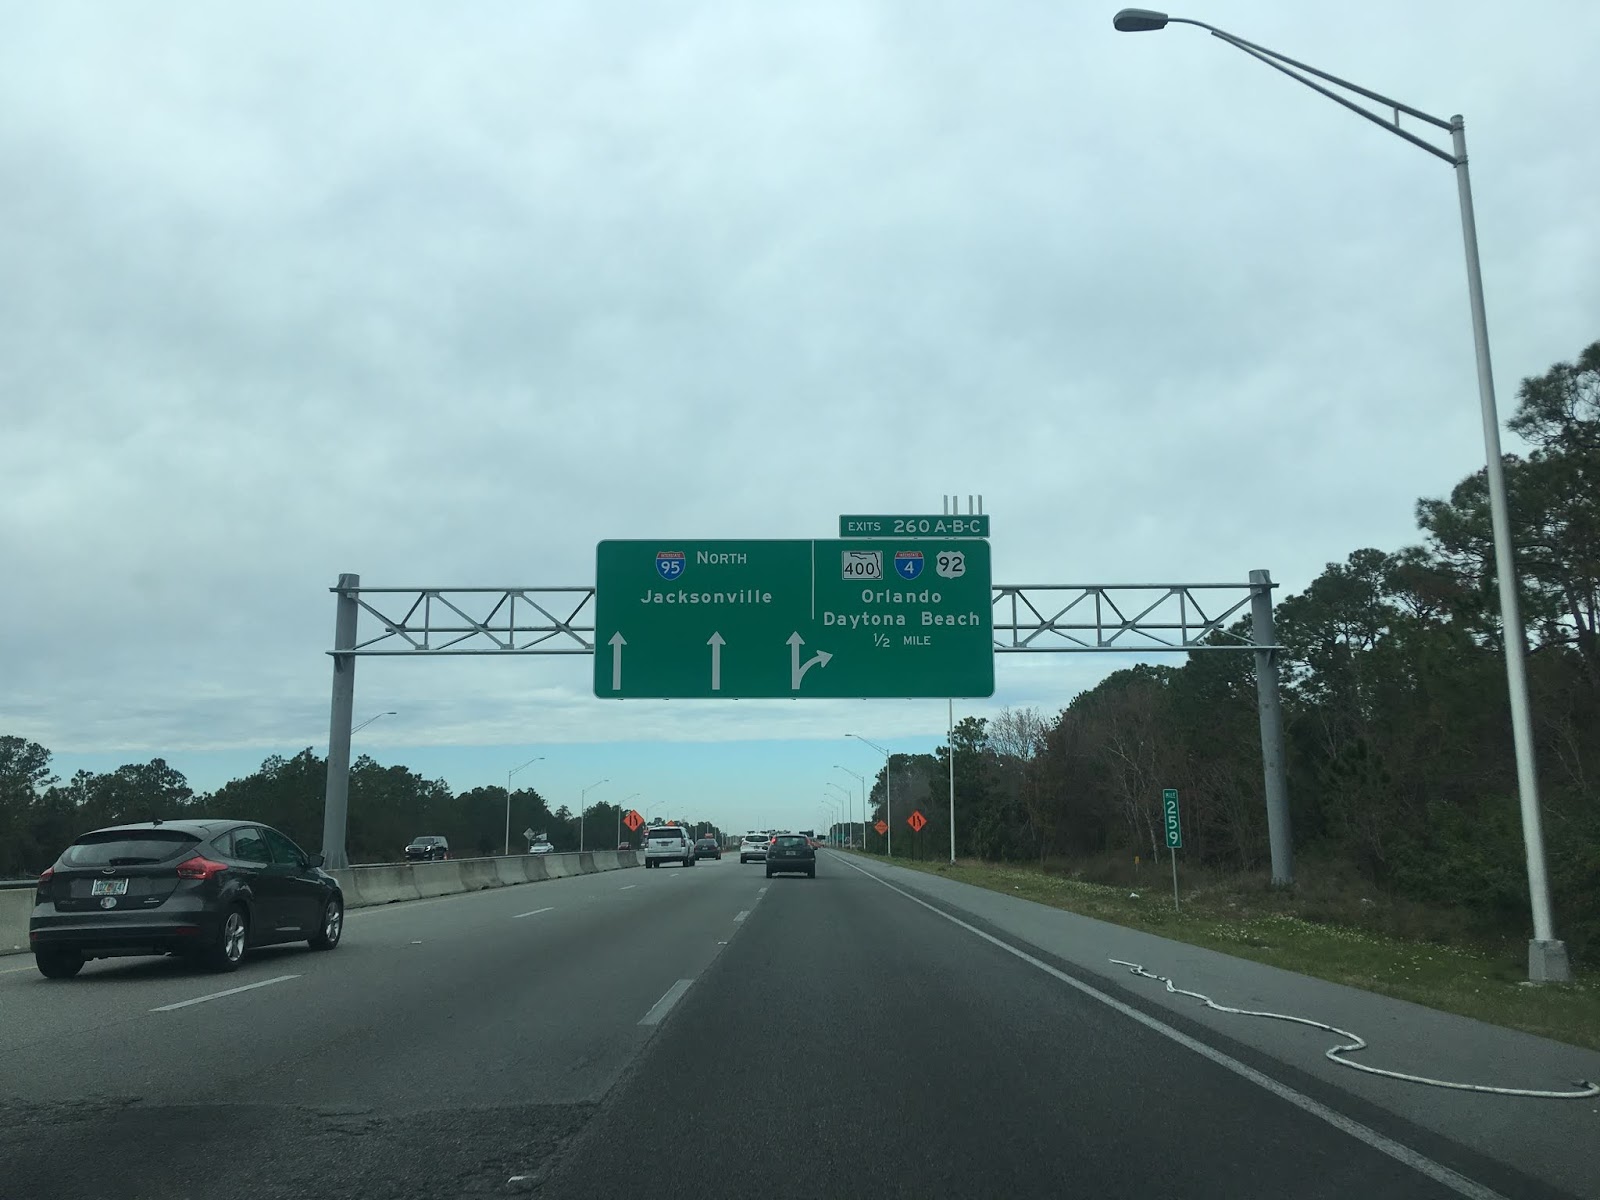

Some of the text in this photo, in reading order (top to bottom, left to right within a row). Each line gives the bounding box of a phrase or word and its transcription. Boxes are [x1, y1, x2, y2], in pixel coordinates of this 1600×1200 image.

[848, 519, 981, 533] EXITS 260 A-B-C
[696, 551, 747, 564] NORTH
[938, 556, 963, 572] 92
[660, 561, 681, 574] 95
[844, 562, 875, 575] 400
[904, 560, 914, 574] 4
[640, 589, 772, 604] Jacksonville
[861, 589, 942, 603] Orlando
[823, 611, 980, 629] Daytona Beach
[903, 635, 931, 646] MILE
